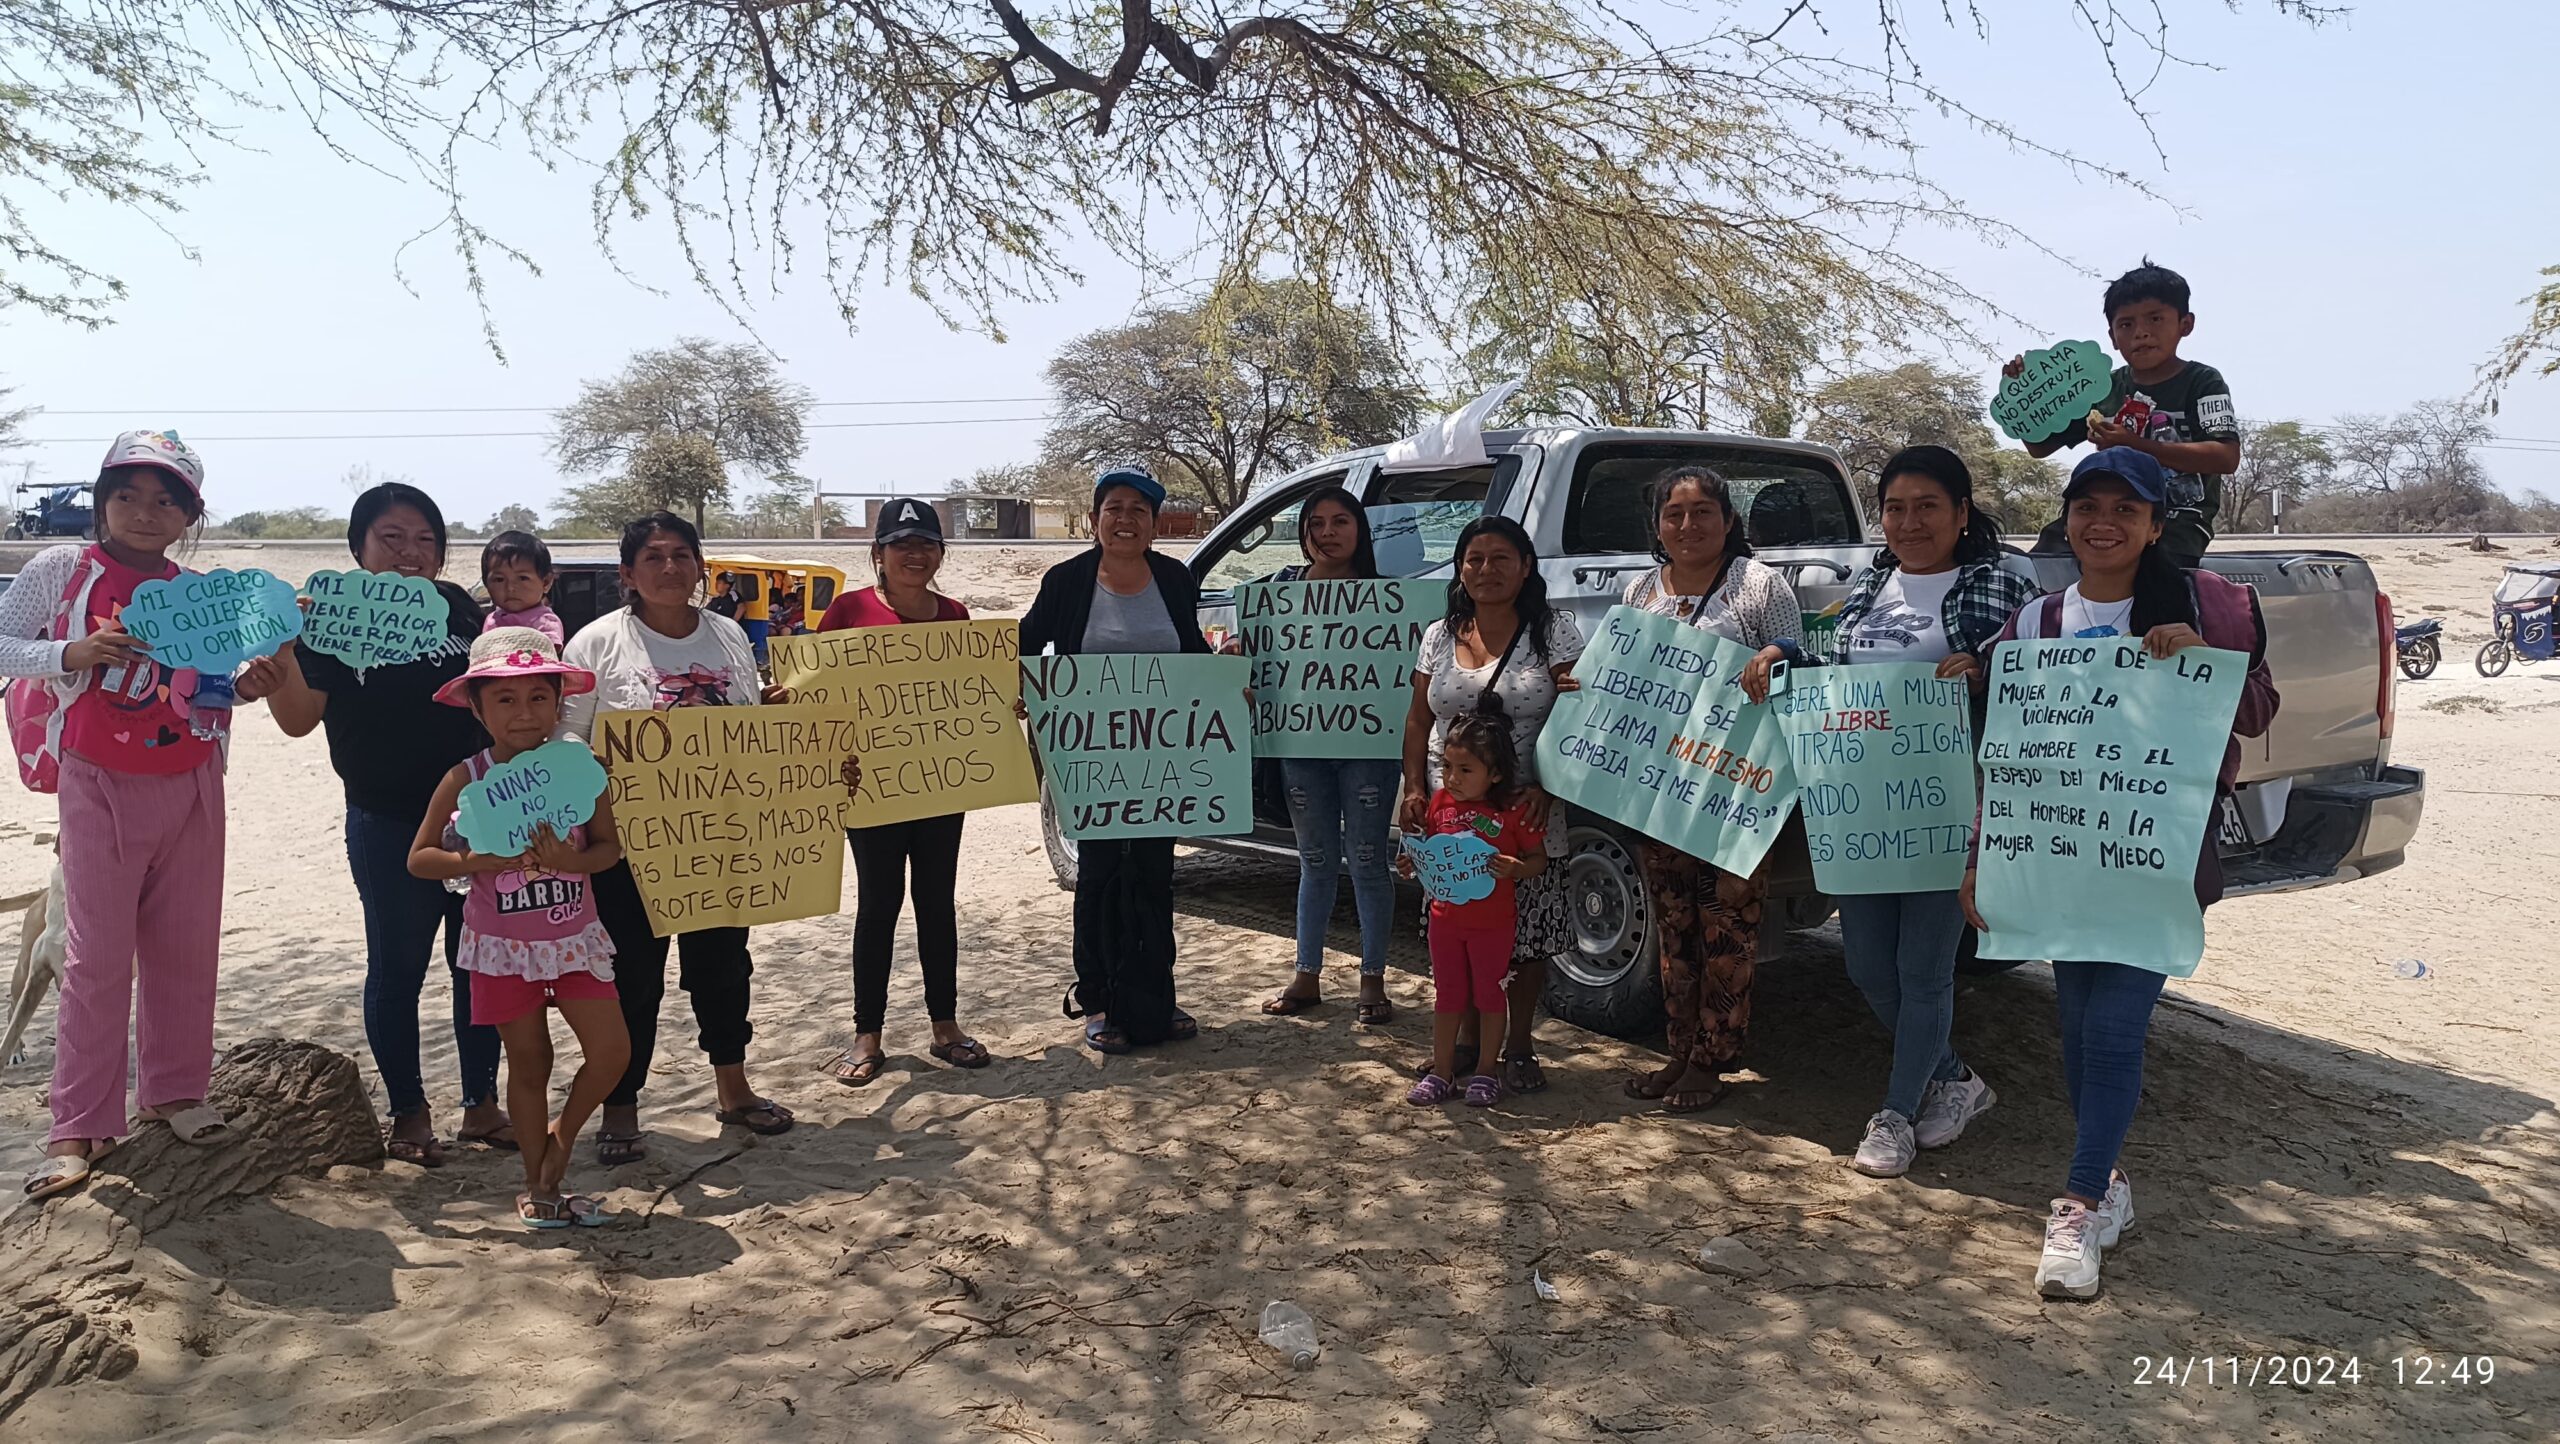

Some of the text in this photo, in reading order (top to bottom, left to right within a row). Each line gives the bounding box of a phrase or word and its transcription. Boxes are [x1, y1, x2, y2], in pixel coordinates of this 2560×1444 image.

[2007, 369, 2037, 396] QUE
[2039, 346, 2076, 374] AMA
[1999, 361, 2084, 425] NO DESTRUYE
[2012, 421, 2031, 436] NI
[899, 502, 920, 521] A
[140, 572, 266, 613] MI CUERPO
[309, 576, 425, 608] MI VIDA
[1242, 579, 1404, 619] LAS NIÑAS
[130, 594, 264, 642] NO QUIERE
[307, 602, 360, 620] IENE
[156, 612, 292, 665] TU OPINIÓN.
[326, 621, 407, 645] CUERPO
[412, 635, 438, 651] NO
[1241, 625, 1274, 657] NO
[1278, 623, 1314, 651] SE
[771, 633, 922, 683] MUJERES
[1302, 661, 1380, 691] PARA
[1649, 642, 1717, 678] MIEDO
[2003, 646, 2213, 683] EL MIEDO DE LA
[1100, 656, 1121, 694] A
[1131, 656, 1168, 697] LA
[1785, 674, 1834, 714] SERÉ
[1843, 680, 1886, 709] UNA
[874, 674, 1005, 719] DEFENSA
[1591, 665, 1736, 731] LIBERTAD SE
[1999, 683, 2119, 708] MUJER A LA
[855, 711, 1001, 753] UESTROS
[1823, 710, 1894, 732] LIBRE
[604, 716, 855, 766] NO al MALTRATO
[1584, 704, 1773, 794] LLAMA MACHISMO
[1984, 740, 2175, 766] DEL HOMBRE ES EL
[485, 761, 551, 808] NIÑAS
[608, 775, 644, 806] DE
[657, 762, 774, 802] NIÑAS,
[1141, 759, 1213, 793] LAS
[1559, 735, 1629, 778] CAMBIA
[1638, 765, 1667, 792] SI
[1667, 776, 1700, 805] ME
[1990, 767, 2042, 788] ESPEJO
[522, 795, 547, 815] NO
[1885, 776, 1946, 811] MAS
[509, 804, 578, 848] MARES
[1074, 795, 1226, 831] UJERES
[1989, 801, 2014, 818] DEL
[2030, 801, 2086, 827] HOMBRE
[2098, 811, 2109, 831] A
[1443, 842, 1463, 858] EL
[1845, 824, 1973, 861] SOMETID
[1985, 834, 2034, 861] MUJER
[674, 853, 762, 878] LEYES
[1429, 873, 1446, 884] YA
[1452, 871, 1469, 883] NO
[1436, 862, 1455, 873] DE
[1464, 852, 1488, 866] LAS
[501, 881, 584, 911] BARBIE
[652, 876, 791, 919] ROTEGEN
